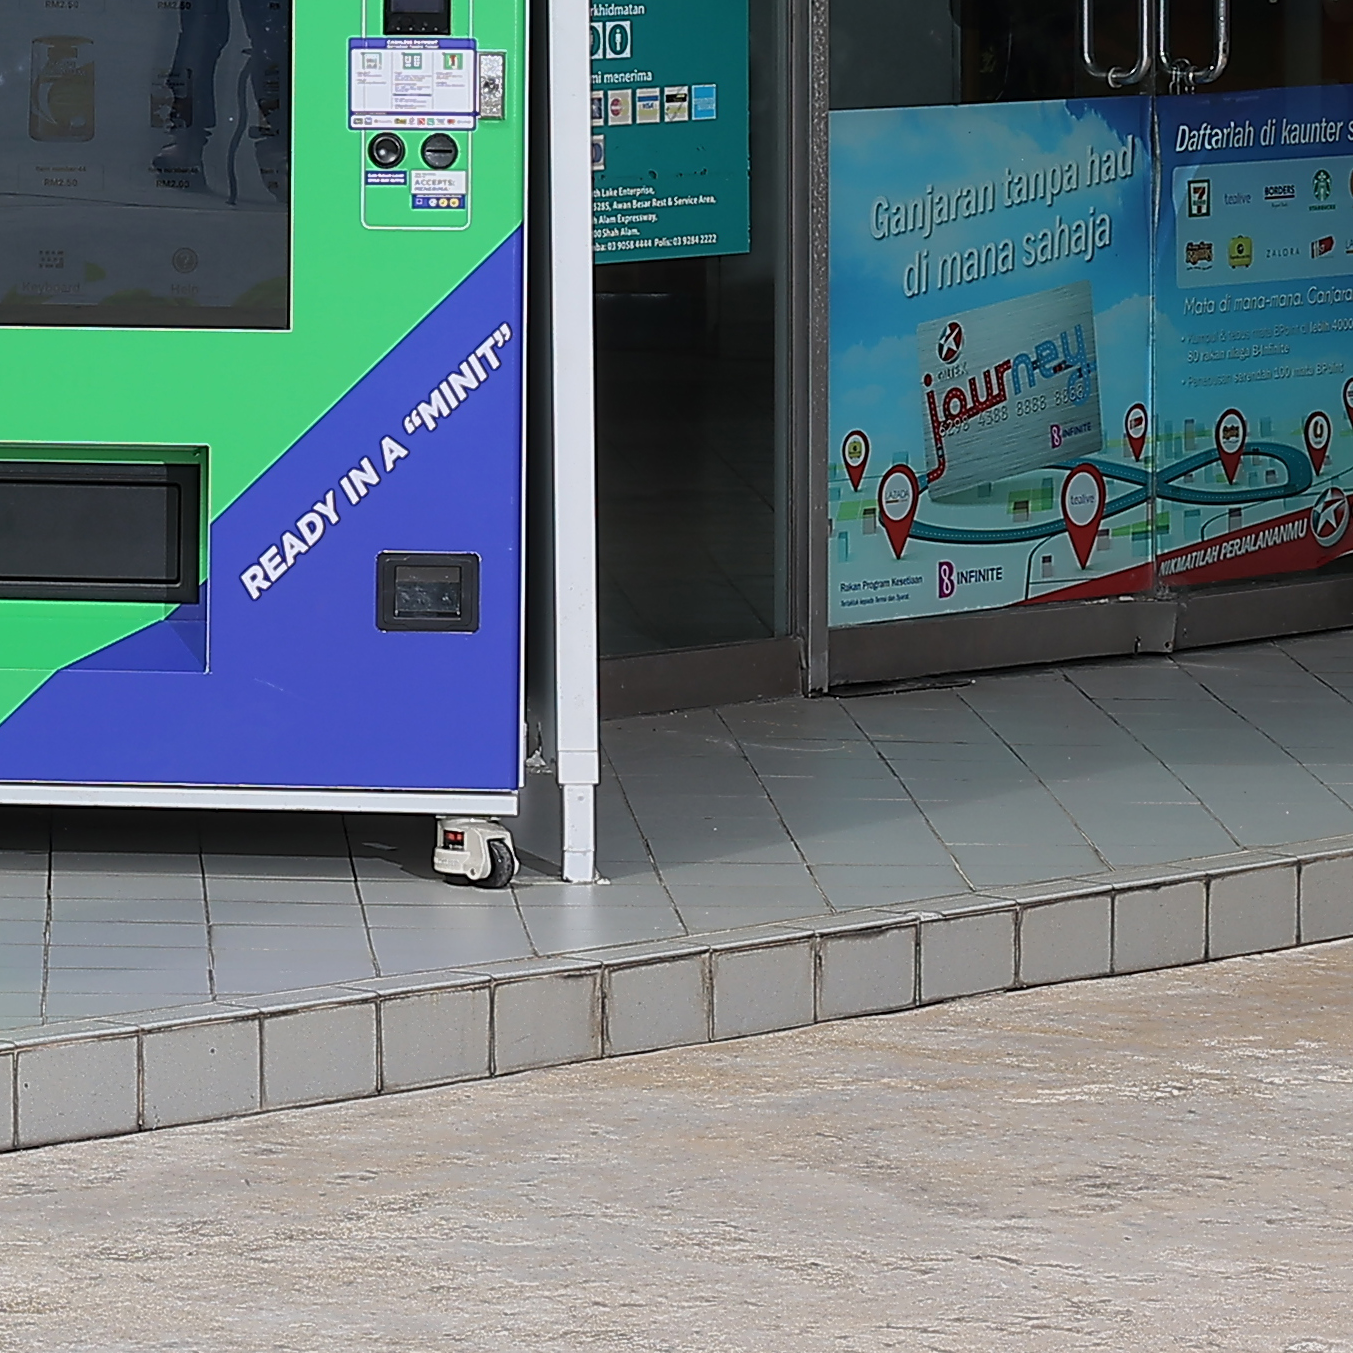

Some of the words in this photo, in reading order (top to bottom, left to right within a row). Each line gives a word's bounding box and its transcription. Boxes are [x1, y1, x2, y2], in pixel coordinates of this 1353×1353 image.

[44, 0, 79, 9] RM2.50
[591, 3, 646, 16] rkhidmatan
[604, 69, 653, 83] menerima
[1175, 120, 1254, 153] Daftarlah
[1260, 118, 1276, 146] di
[1281, 117, 1344, 145] kaunter
[602, 187, 618, 197] Lake
[870, 180, 995, 240] Ganjaran
[1003, 160, 1079, 207] tanpa
[1085, 134, 1134, 187] had
[1264, 184, 1295, 196] BORDERS
[613, 199, 631, 209] Awan
[633, 198, 651, 208] Besar
[652, 197, 667, 207] Rest
[668, 197, 673, 206] &
[674, 195, 698, 206] Service
[1224, 193, 1251, 205] tealive
[599, 215, 616, 224] Alam
[603, 228, 619, 238] Shah
[608, 242, 616, 250] 03
[673, 236, 682, 245] 03
[700, 234, 717, 244] 2222
[902, 248, 929, 299] di
[937, 237, 1015, 290] mana
[1022, 206, 1112, 267] sahaja
[1266, 247, 1300, 259] ZALORA
[22, 279, 80, 295] Keyboard
[170, 281, 200, 296] Help
[1183, 297, 1215, 315] Mata
[1219, 293, 1231, 312] di
[1233, 293, 1303, 311] mana-mana.
[1201, 350, 1225, 362] rakan
[922, 323, 1097, 484] journey
[939, 416, 970, 438] 6298
[1016, 395, 1047, 417] 8888
[1062, 421, 1092, 439] INFINITE
[884, 489, 909, 500] LAZADA
[1070, 493, 1095, 505] tealive
[239, 489, 341, 600] READY
[338, 456, 382, 506] IN
[380, 434, 410, 473] A
[1157, 544, 1219, 577] NIKMATILAH
[1219, 518, 1308, 561] PERJALANANMU
[840, 582, 861, 592] Rakan
[862, 579, 890, 591] Program
[891, 575, 923, 587] Kesetiaan
[956, 567, 1003, 585] INFINITE
